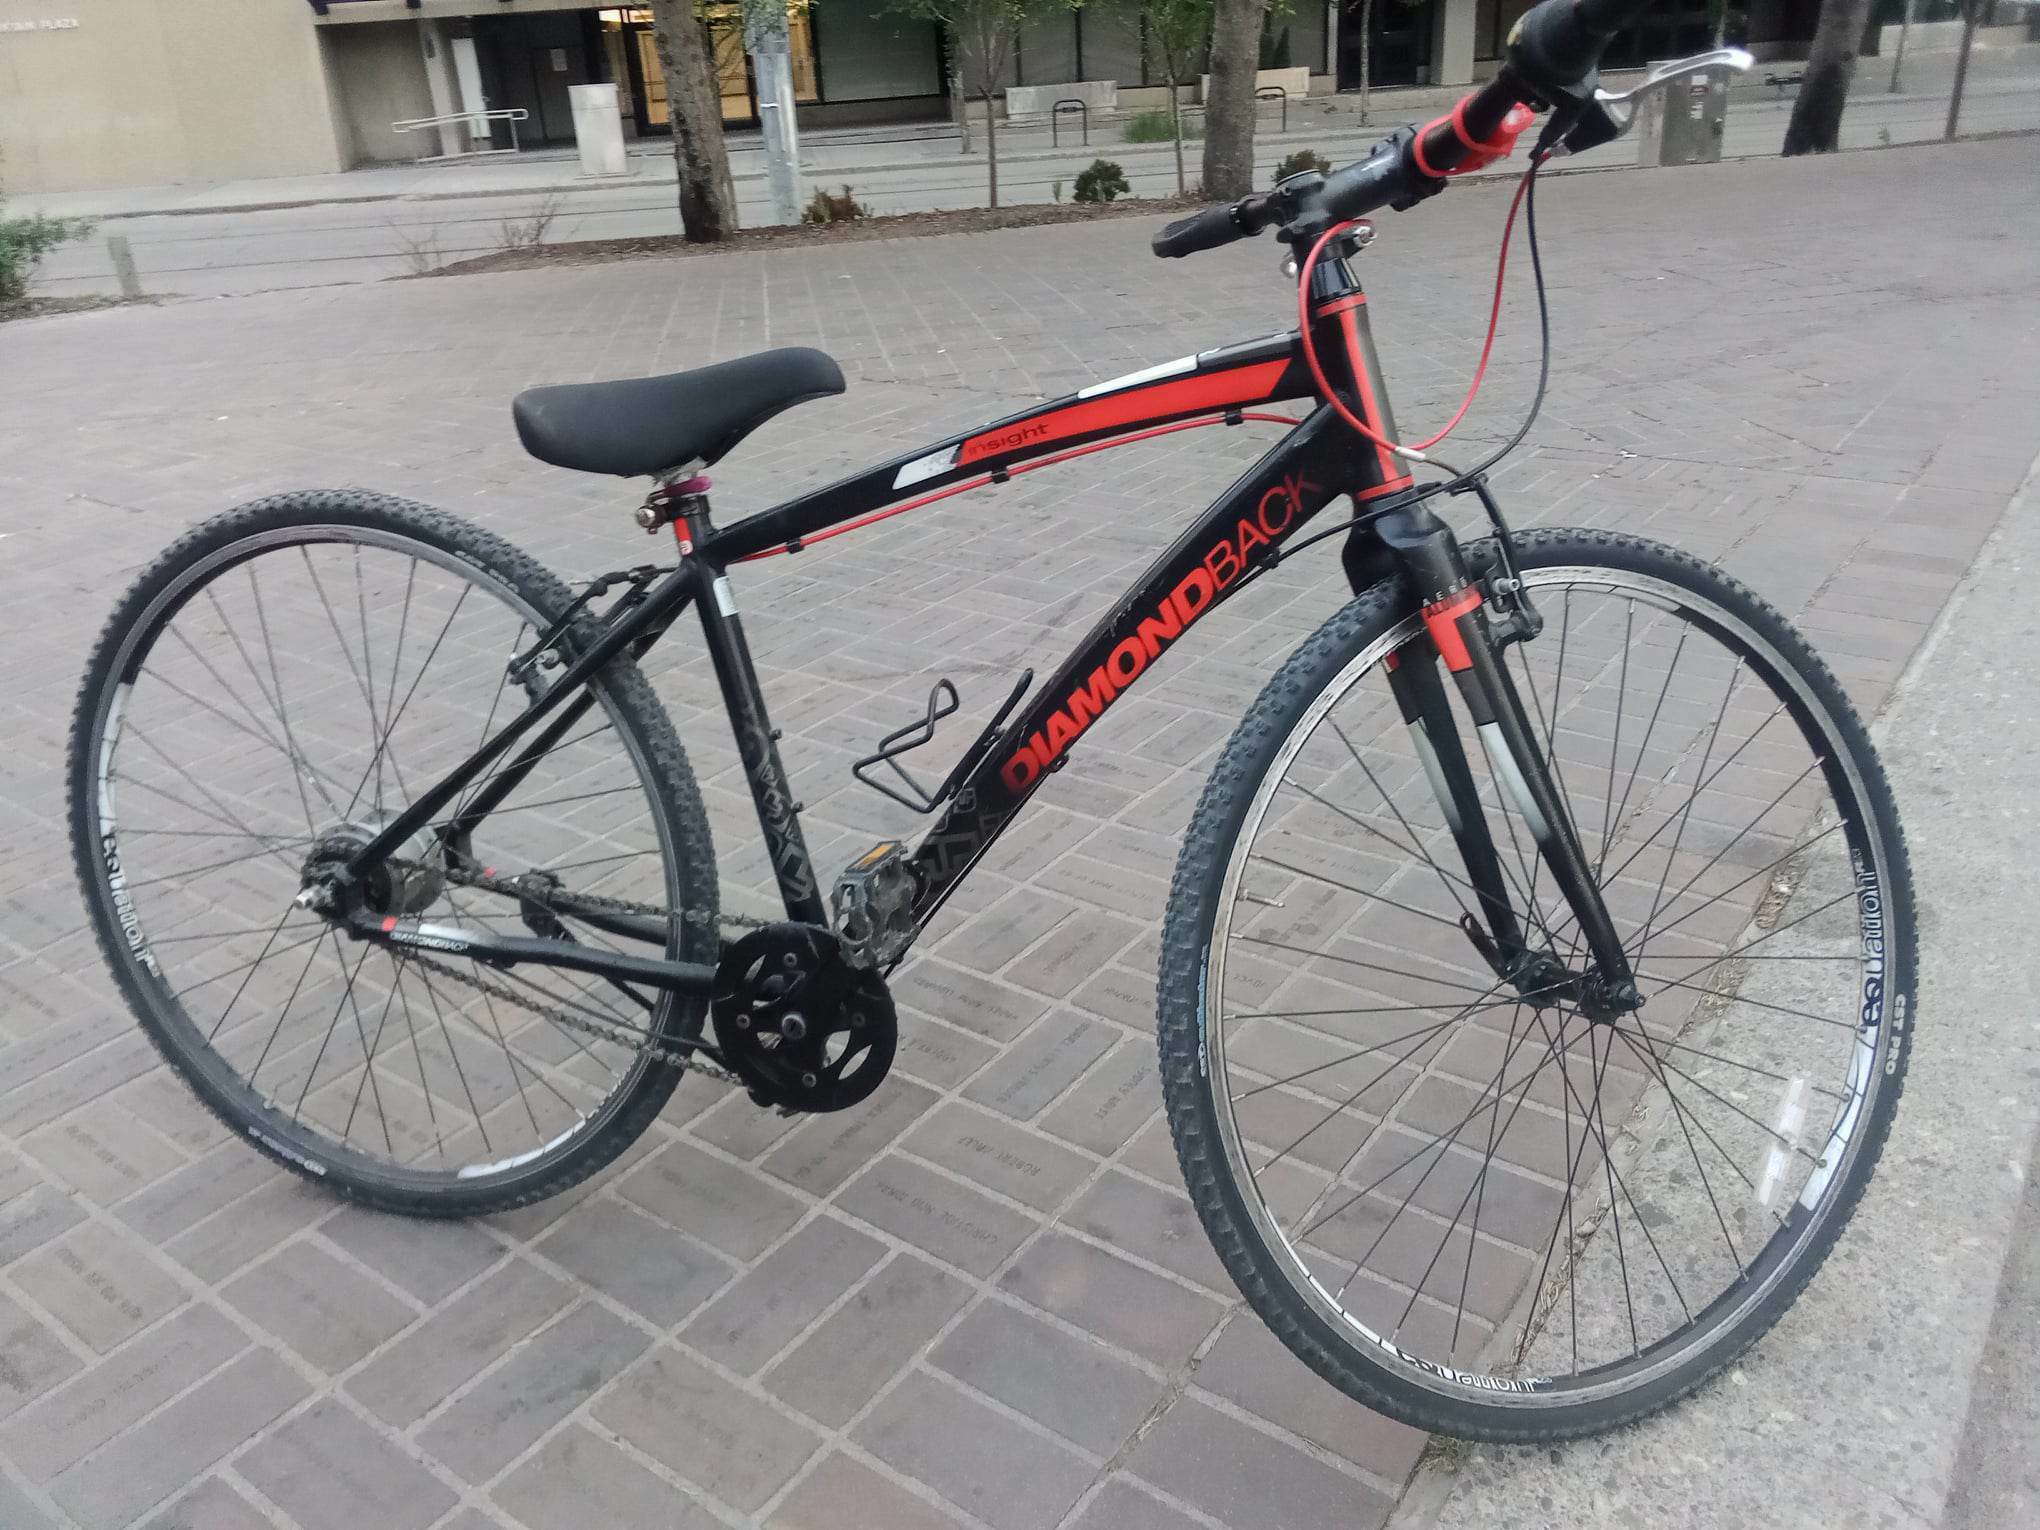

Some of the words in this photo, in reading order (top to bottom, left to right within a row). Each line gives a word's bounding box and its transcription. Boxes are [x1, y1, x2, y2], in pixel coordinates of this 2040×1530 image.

[967, 423, 1049, 457] insight
[1000, 468, 1322, 794] DIAMONDBACK
[1856, 871, 1884, 1028] equation
[1894, 993, 1907, 1032] CST
[1886, 1035, 1903, 1075] PRO
